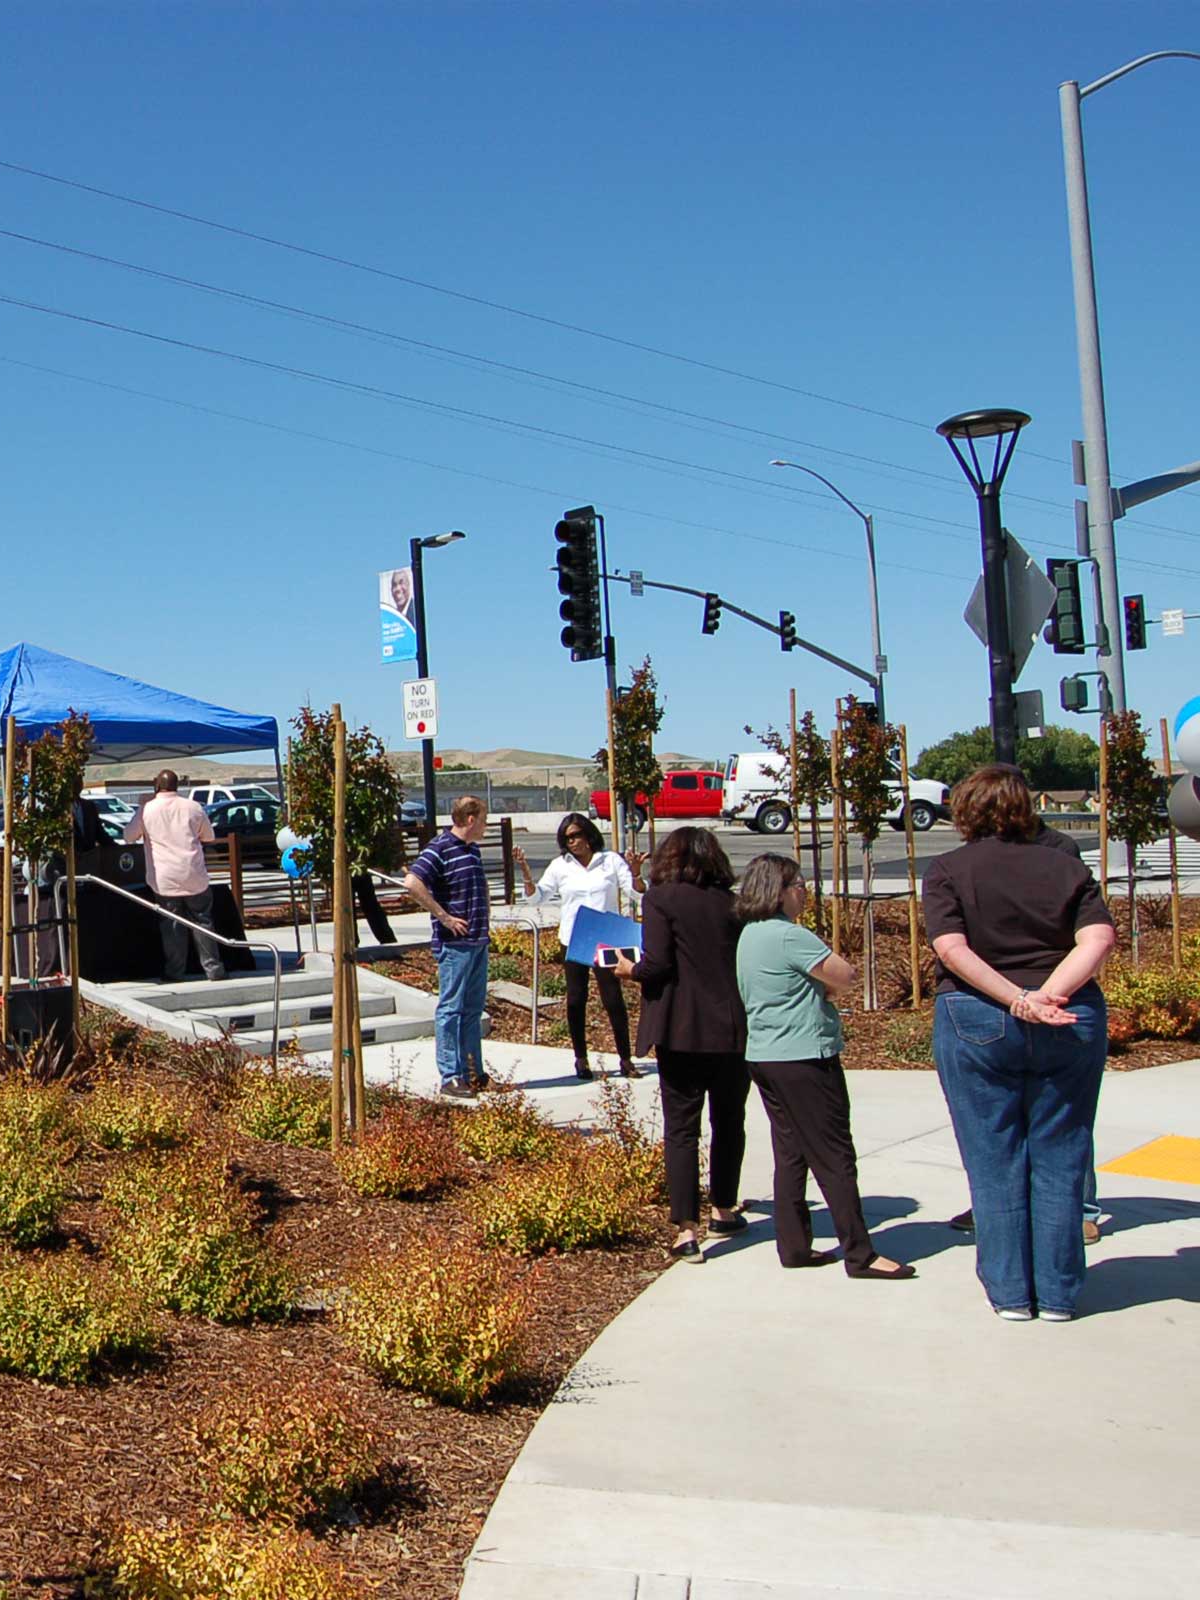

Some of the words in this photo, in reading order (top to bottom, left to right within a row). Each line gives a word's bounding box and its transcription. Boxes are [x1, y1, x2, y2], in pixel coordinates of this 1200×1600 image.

[411, 684, 427, 696] NO
[411, 698, 430, 708] TURN
[407, 711, 418, 720] ON
[420, 709, 434, 719] RED
